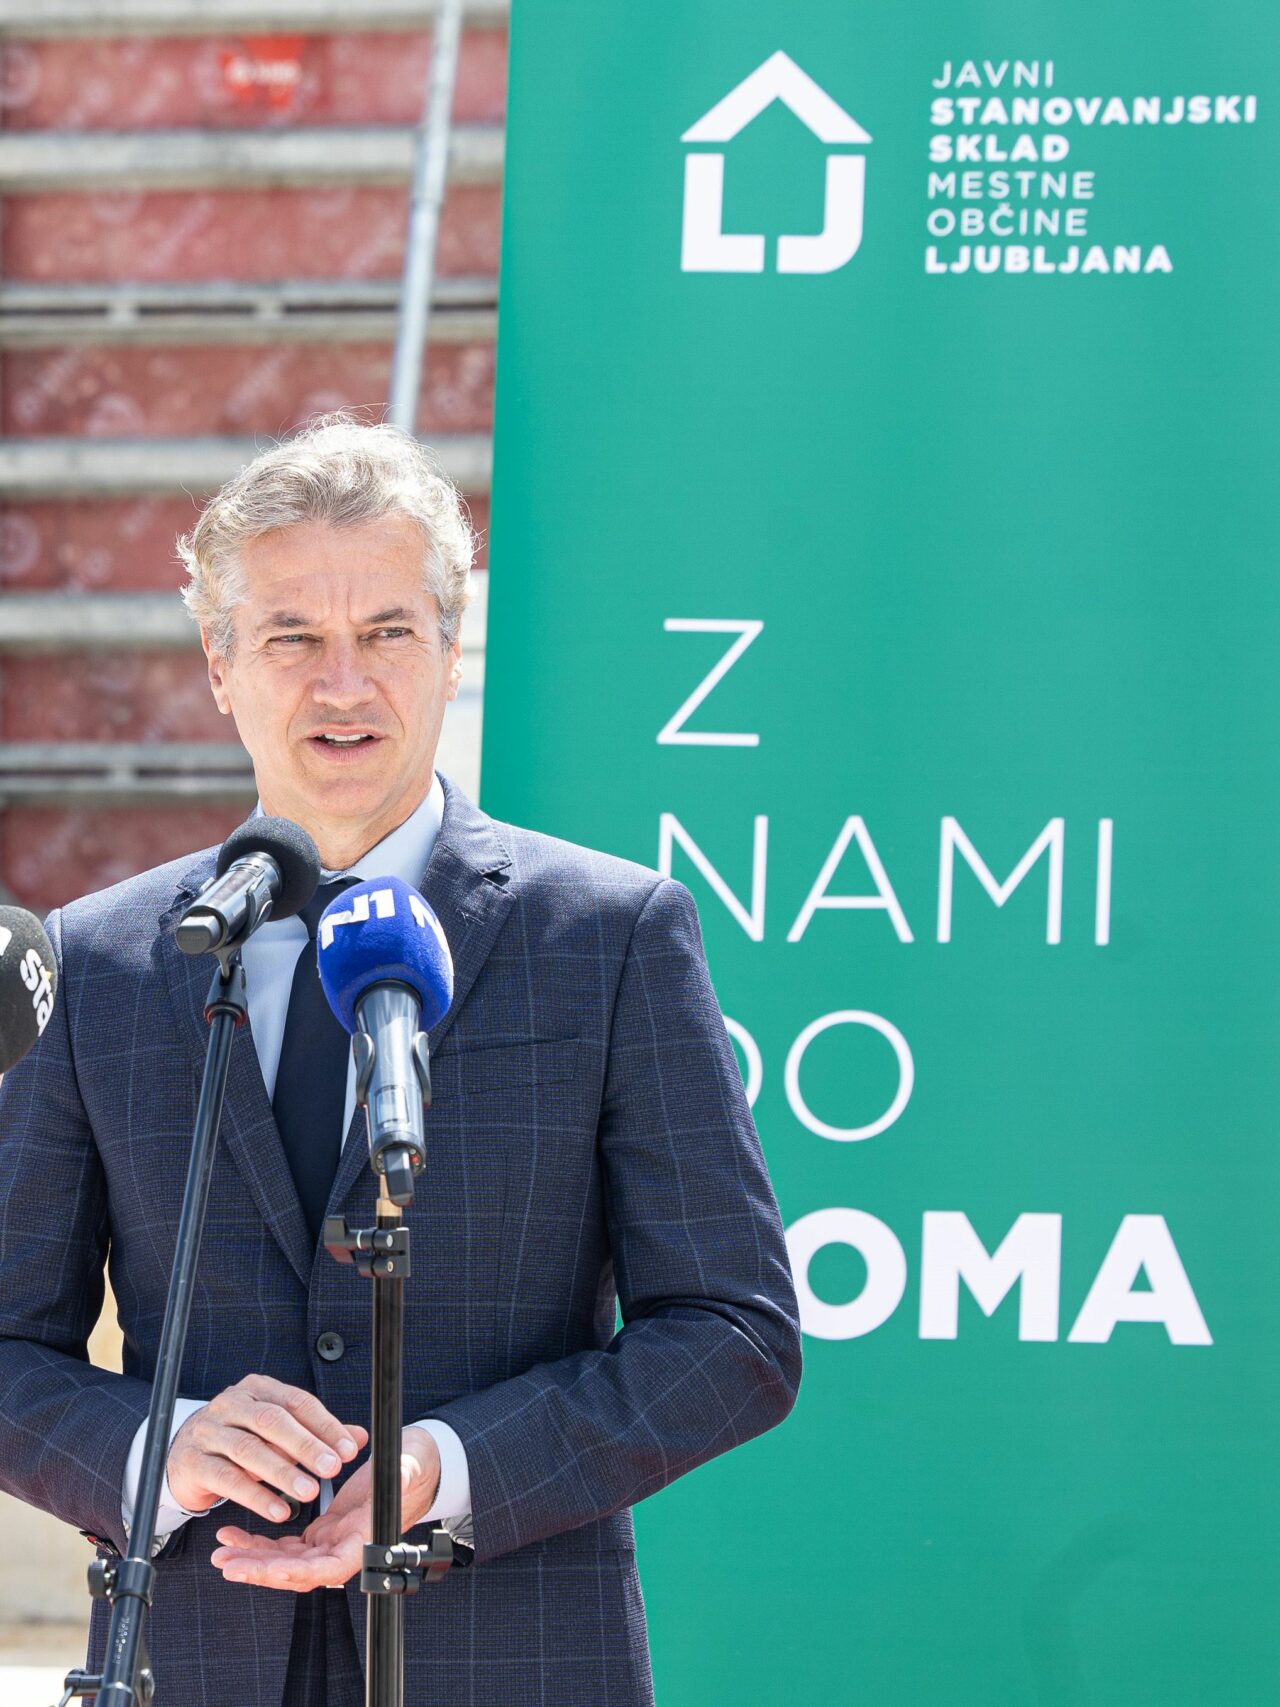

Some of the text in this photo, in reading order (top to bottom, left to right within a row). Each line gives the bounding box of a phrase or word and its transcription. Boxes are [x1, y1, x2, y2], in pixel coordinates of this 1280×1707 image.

[932, 60, 1054, 90] JAVNI
[930, 95, 1257, 126] STANOVANJSKI
[929, 134, 1070, 163] SKLAD
[927, 170, 1095, 200] MESTNE
[927, 203, 1088, 238] OBČINE
[924, 244, 1173, 274] LJUBLJANA
[657, 618, 764, 747] Z
[658, 812, 1113, 946] NAMI
[784, 1207, 1214, 1346] OMA
